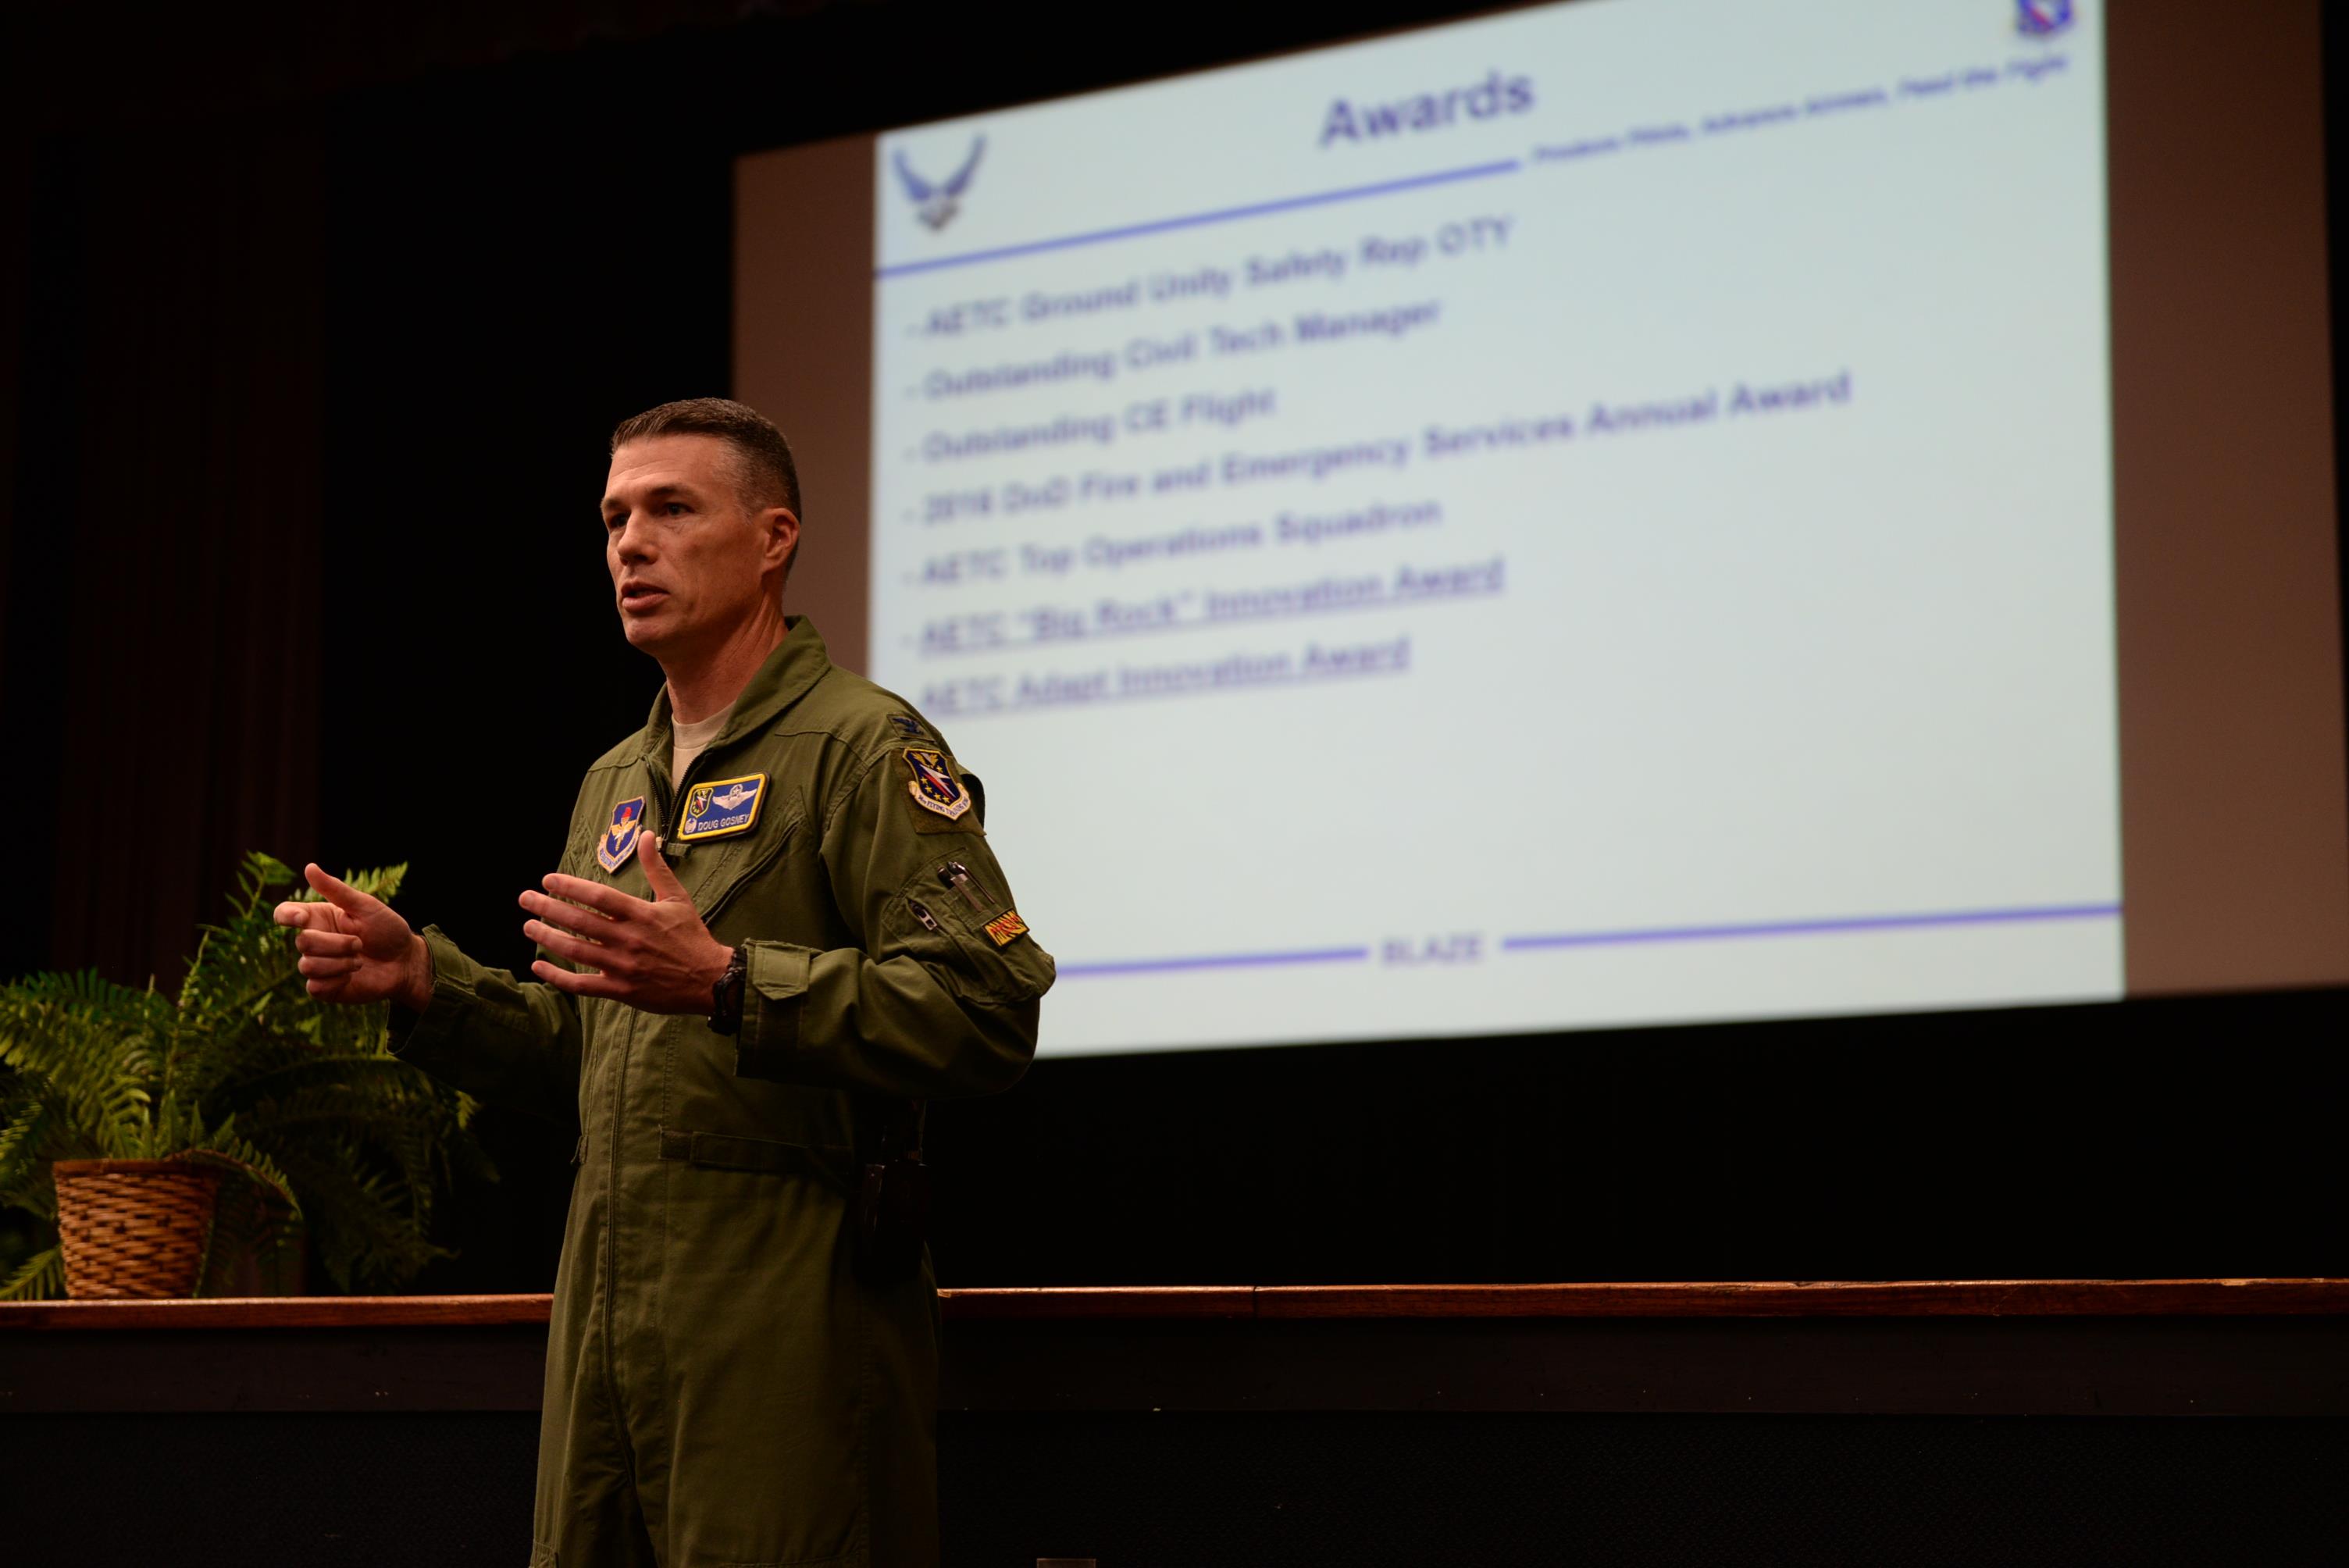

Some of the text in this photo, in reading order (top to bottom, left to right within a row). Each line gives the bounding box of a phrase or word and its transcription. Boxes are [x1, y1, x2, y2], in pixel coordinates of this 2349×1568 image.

[1318, 72, 1535, 146] Awards
[921, 298, 1012, 337] AETC
[1020, 278, 1140, 323] Ground
[1243, 249, 1349, 287] Safety
[1357, 236, 1429, 266] Rep
[1435, 216, 1513, 256] OTY
[922, 302, 1439, 400] Outstanding Civil Tech Manager
[921, 387, 1276, 462] Outstanding CE Flight
[1078, 472, 1141, 501] Fire
[1149, 461, 1212, 494] and
[1218, 438, 1412, 486] Emergency
[1421, 415, 1575, 458] Services
[1584, 389, 1718, 434] Annual
[1727, 371, 1850, 415] Award
[921, 500, 1442, 586] AETC Top Operations Squadron
[920, 613, 1005, 656] AETC
[1207, 576, 1385, 622] Innovation
[1394, 558, 1505, 602] Award
[921, 636, 1410, 715] AETC Adapt Innovation Award
[698, 814, 750, 831] DOUG GOSNEY
[1380, 932, 1483, 967] BLAZE
